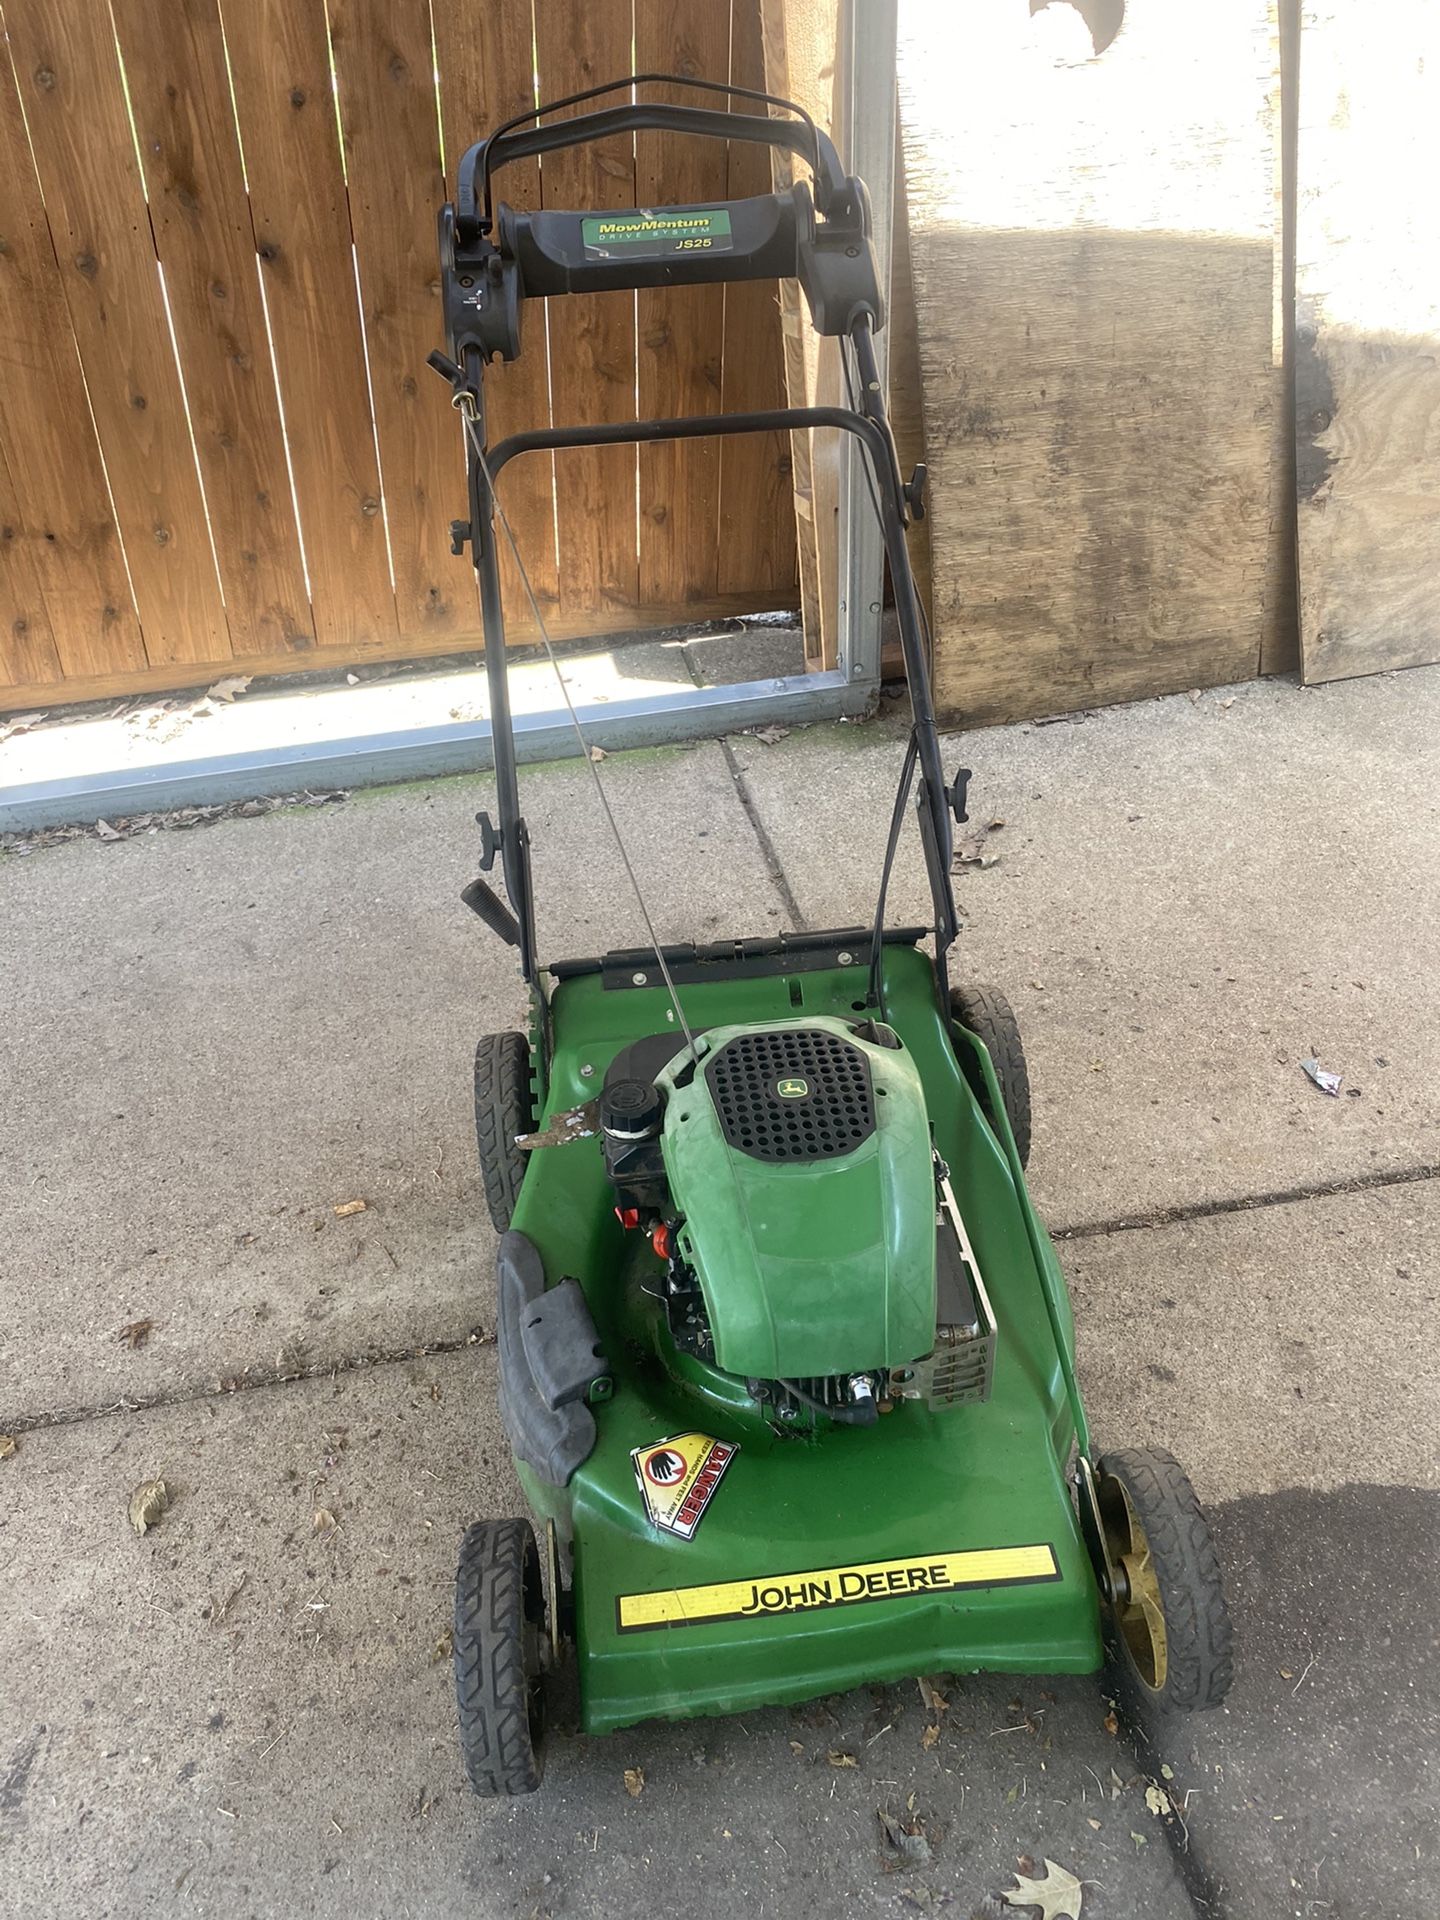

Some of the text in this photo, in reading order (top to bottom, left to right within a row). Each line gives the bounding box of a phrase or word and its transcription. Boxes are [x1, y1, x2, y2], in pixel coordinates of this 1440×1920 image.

[598, 227, 710, 241] DRIVE SYSTEM
[599, 218, 709, 233] MowMentum
[675, 238, 713, 250] JS25
[701, 1440, 712, 1454] KEEP
[689, 1453, 703, 1474] HANDS
[676, 1485, 687, 1502] FEET
[677, 1445, 730, 1526] DANGER
[665, 1502, 678, 1520] AWAY
[741, 1564, 951, 1612] JOHN DEERE
